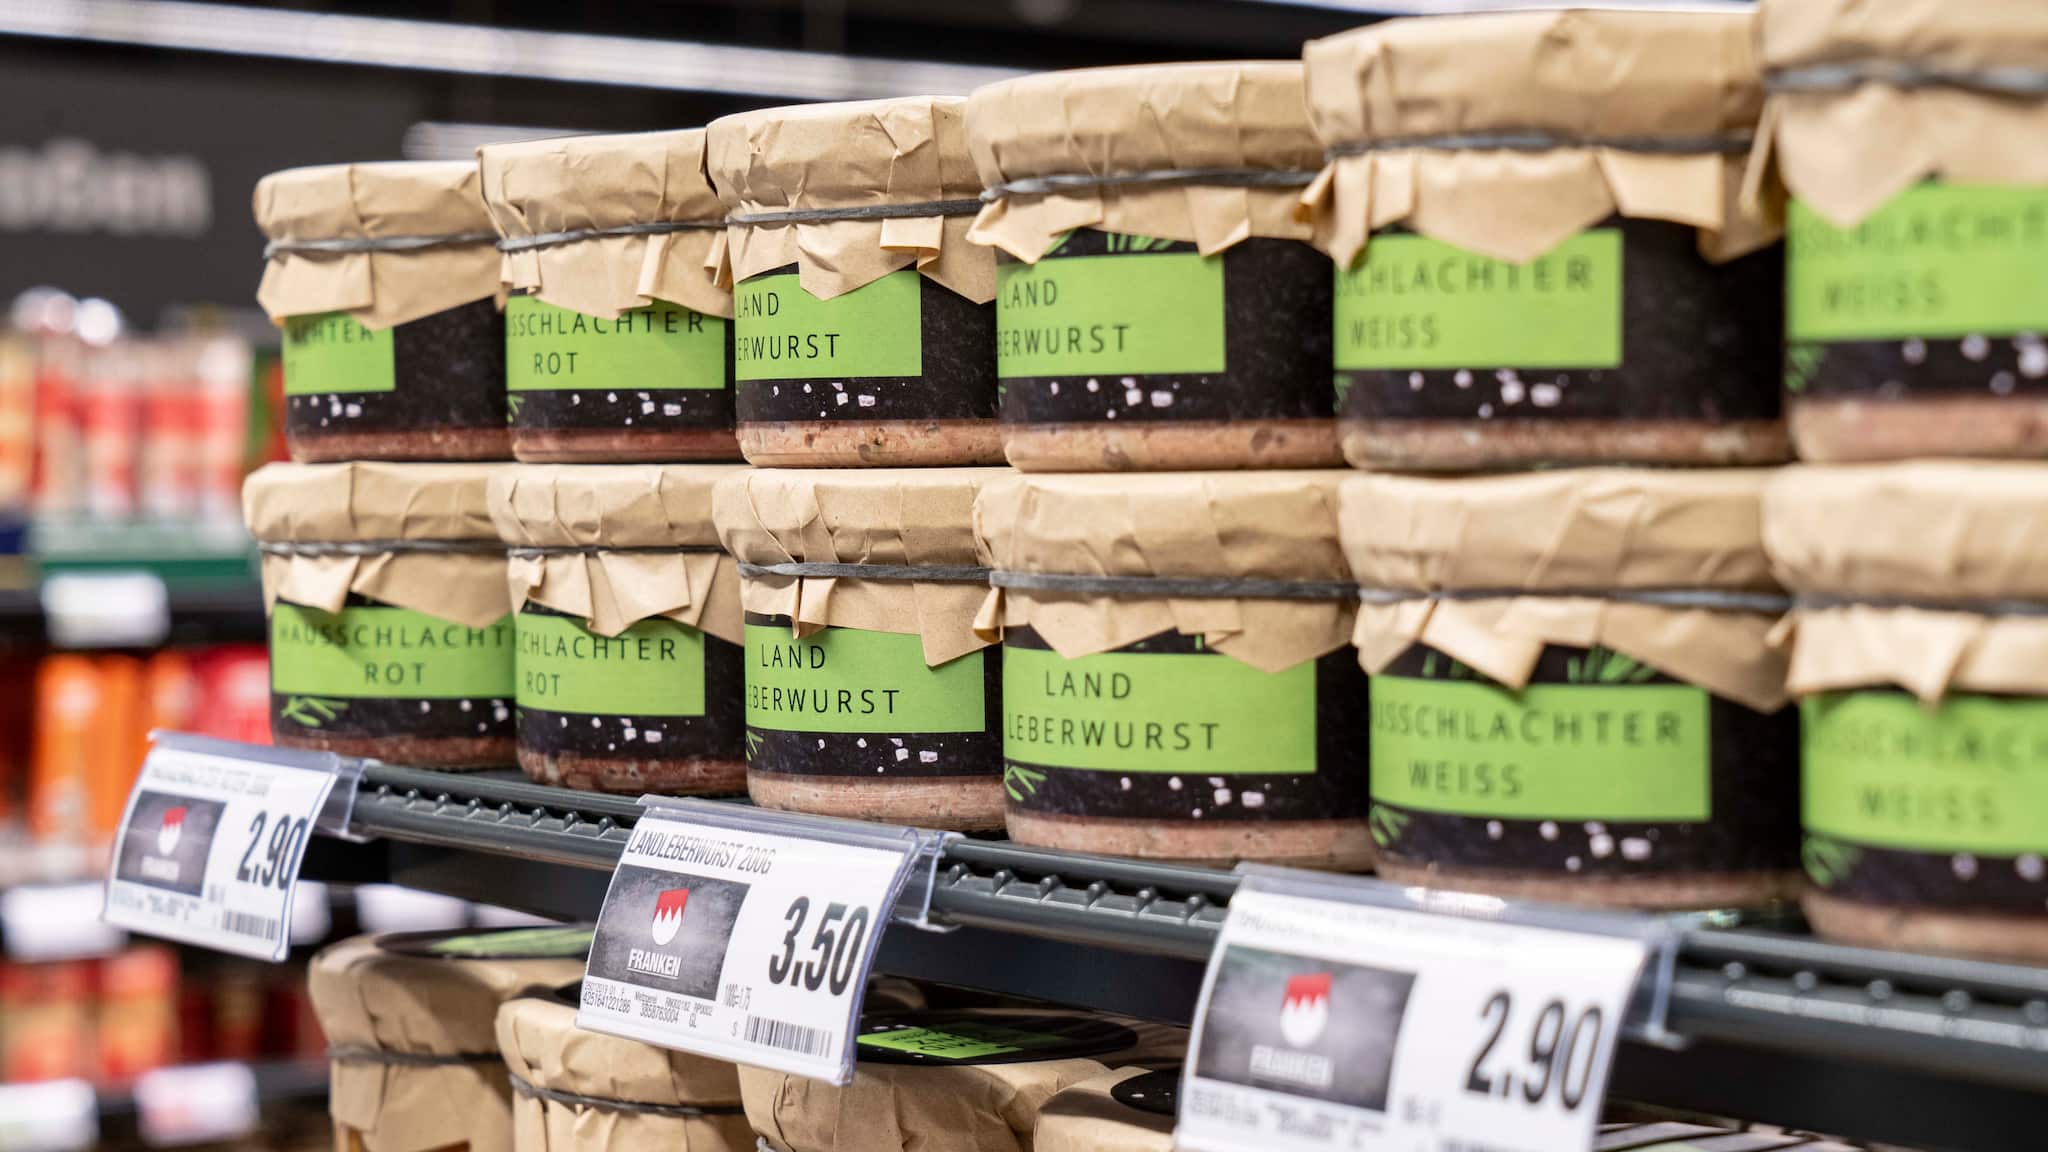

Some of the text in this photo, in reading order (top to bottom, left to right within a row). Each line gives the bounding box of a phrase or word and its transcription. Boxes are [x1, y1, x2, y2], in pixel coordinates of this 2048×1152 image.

[1003, 279, 1058, 309] LAND
[1350, 313, 1438, 349] WEISS
[534, 352, 579, 375] ROT
[762, 643, 826, 669] LAND
[365, 662, 426, 685] ROT
[527, 671, 561, 697] ROT
[1046, 670, 1132, 699] LAND
[1009, 713, 1219, 750] LEBERWURST
[1408, 758, 1524, 797] WEISS
[627, 829, 744, 869] LANDLEBERWURST
[769, 895, 869, 996] 3.50
[627, 949, 681, 977] FRANKEN
[1466, 990, 1603, 1110] 2.90
